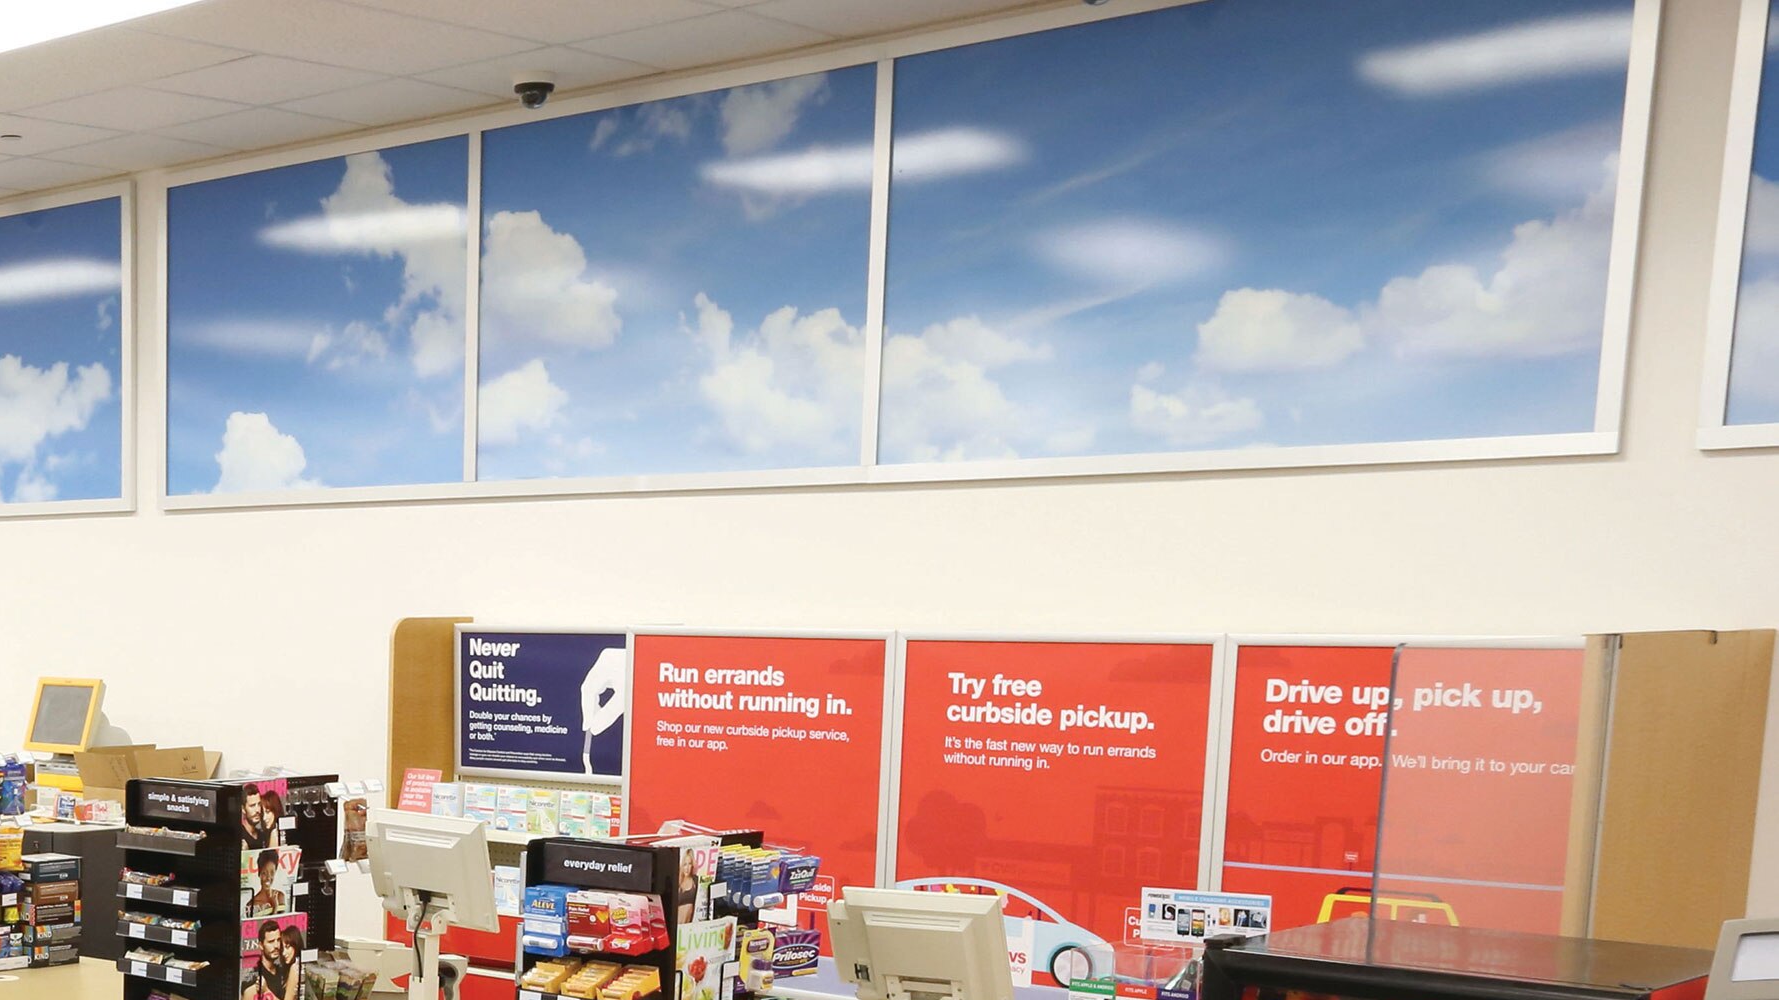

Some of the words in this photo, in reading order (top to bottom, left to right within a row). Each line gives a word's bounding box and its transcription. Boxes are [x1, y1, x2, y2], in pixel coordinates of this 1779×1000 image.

[469, 637, 521, 657] Never
[469, 660, 505, 679] Quit
[659, 663, 701, 684] Run
[704, 666, 785, 688] errands
[469, 682, 543, 707] Quitting.
[948, 672, 986, 698] Try
[991, 673, 1042, 697] free
[1265, 678, 1343, 705] Drive
[1352, 682, 1403, 711] up,
[1413, 681, 1482, 711] pick
[1491, 687, 1543, 713] up,
[657, 688, 736, 711] without
[738, 693, 820, 719] running
[825, 695, 853, 716] in.
[469, 710, 493, 720] Double
[493, 712, 510, 722] your
[510, 712, 541, 722] chances
[542, 713, 552, 724] by
[946, 701, 1053, 726] curbside
[1059, 705, 1155, 733] pickup.
[1263, 710, 1336, 735] drive
[1344, 711, 1398, 737] off.
[469, 721, 492, 731] getting
[493, 723, 533, 734] counseling,
[534, 725, 568, 735] medicine
[656, 720, 682, 735] Shop
[684, 723, 702, 734] our
[703, 724, 724, 735] new
[725, 722, 770, 738] curbside
[771, 725, 807, 742] pickup
[808, 728, 851, 743] service,
[656, 735, 675, 748] free
[676, 736, 686, 748] in
[688, 739, 705, 749] our
[707, 740, 728, 752] app.
[944, 736, 961, 749] It's
[963, 737, 983, 750] the
[985, 737, 1008, 751] fast
[1010, 741, 1036, 752] new
[1038, 742, 1064, 757] way
[1067, 743, 1080, 754] to
[1082, 745, 1104, 756] run
[1106, 745, 1157, 759] errands
[943, 752, 985, 767] without
[988, 755, 1033, 771] running
[1036, 756, 1051, 769] in.
[1260, 748, 1302, 765] Order
[1305, 750, 1318, 765] in
[1321, 753, 1347, 766] our
[1349, 755, 1383, 772] app.
[1391, 753, 1426, 770] We'll
[1431, 756, 1471, 774] bring
[1474, 756, 1485, 772] it
[1488, 759, 1506, 773] to
[1509, 761, 1545, 777] your
[147, 791, 170, 803] simple
[171, 793, 177, 802] &
[177, 794, 210, 808] satisfying
[166, 803, 191, 814] snacks
[240, 850, 302, 875] Luky
[564, 858, 606, 873] everyday
[607, 862, 633, 874] relief
[799, 893, 828, 904] Pickup
[772, 948, 816, 962] Prilosec
